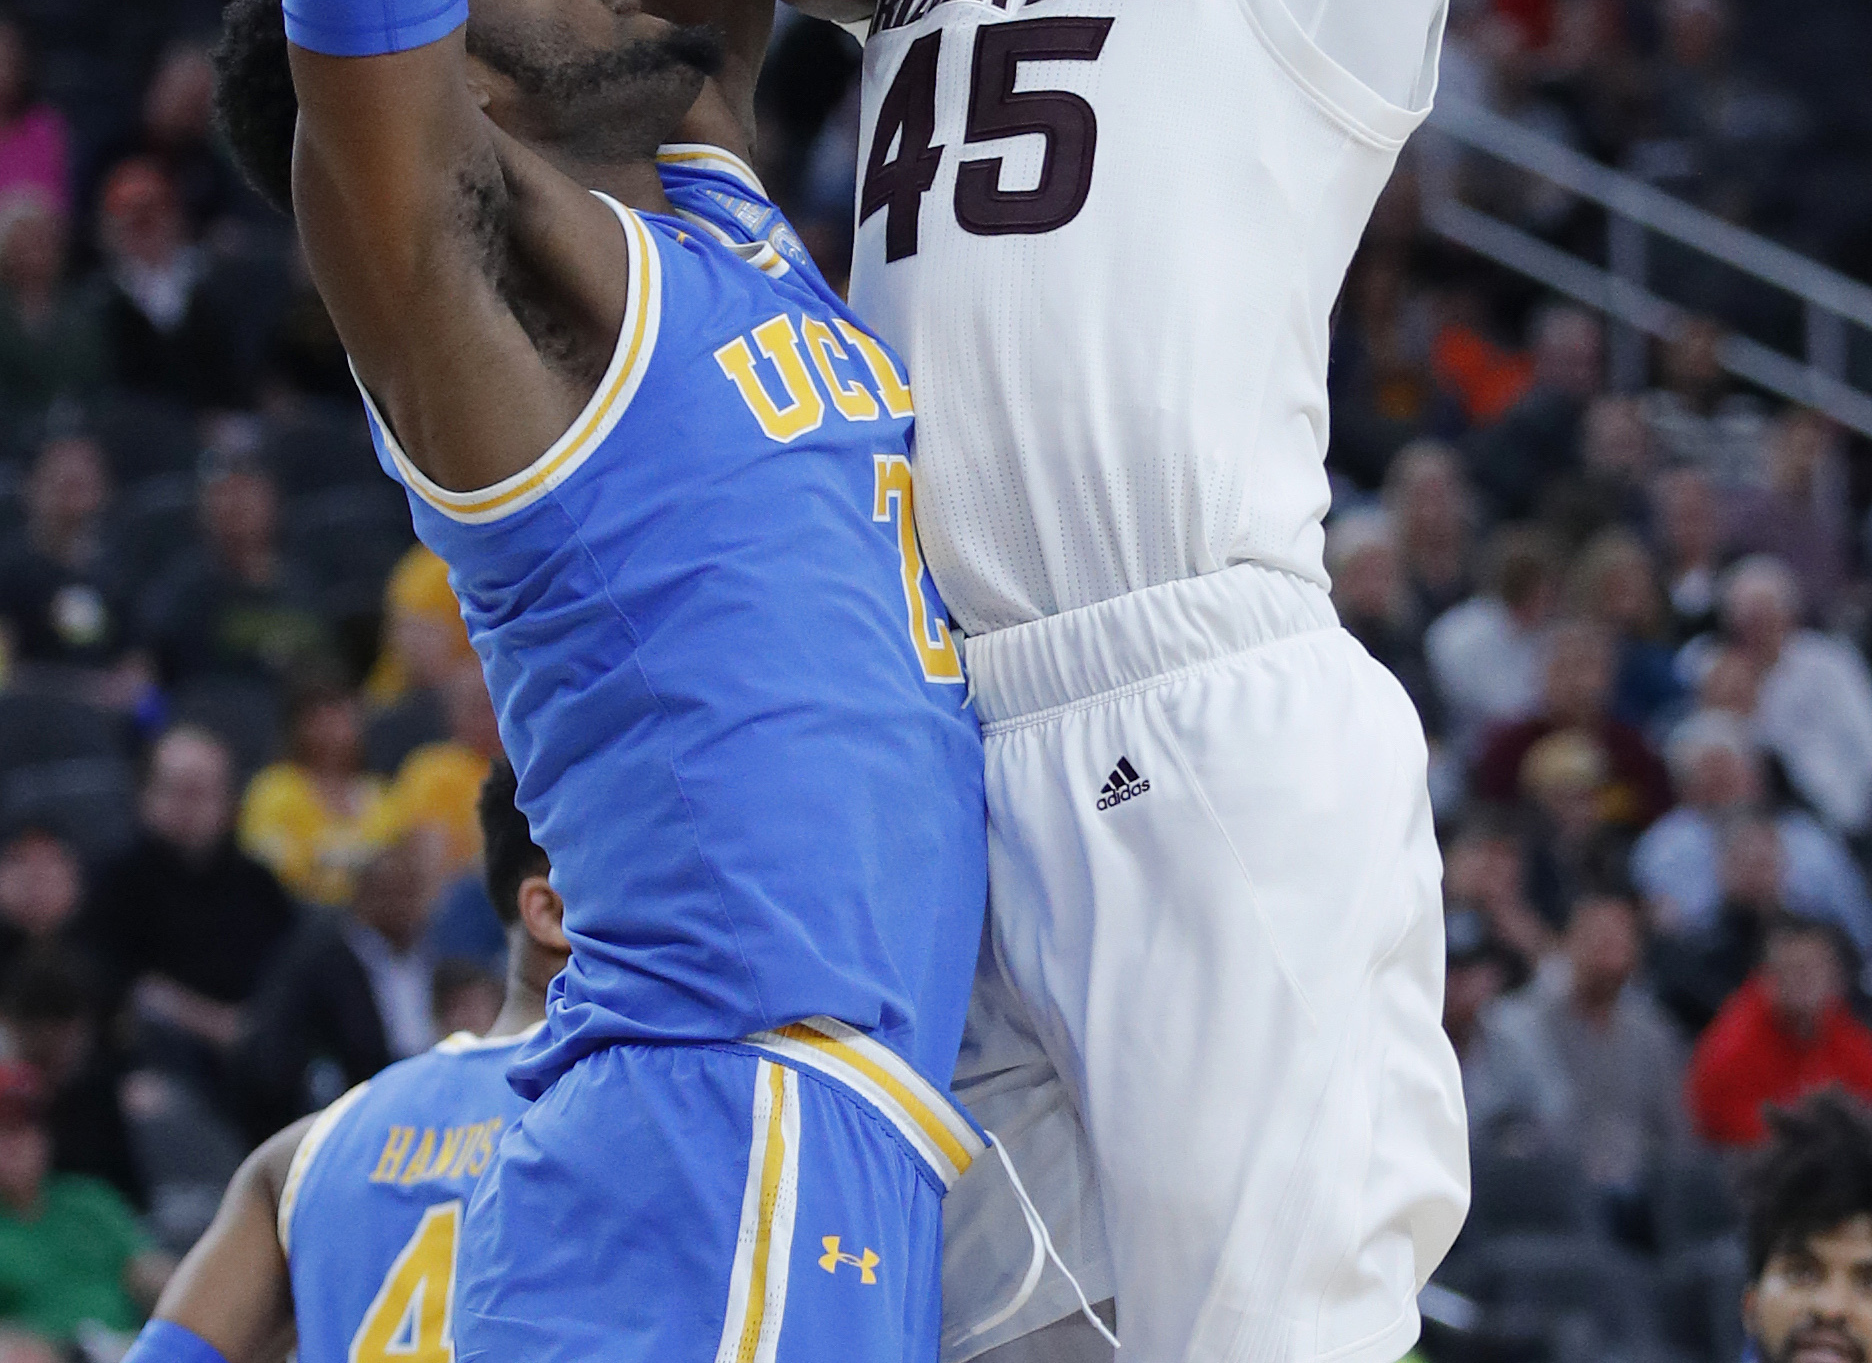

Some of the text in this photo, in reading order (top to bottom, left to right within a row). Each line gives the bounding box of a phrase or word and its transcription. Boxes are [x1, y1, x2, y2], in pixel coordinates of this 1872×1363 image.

[859, 16, 1116, 264] 45
[713, 312, 916, 444] UCL
[1096, 779, 1151, 811] adidas
[348, 1198, 464, 1363] 4
